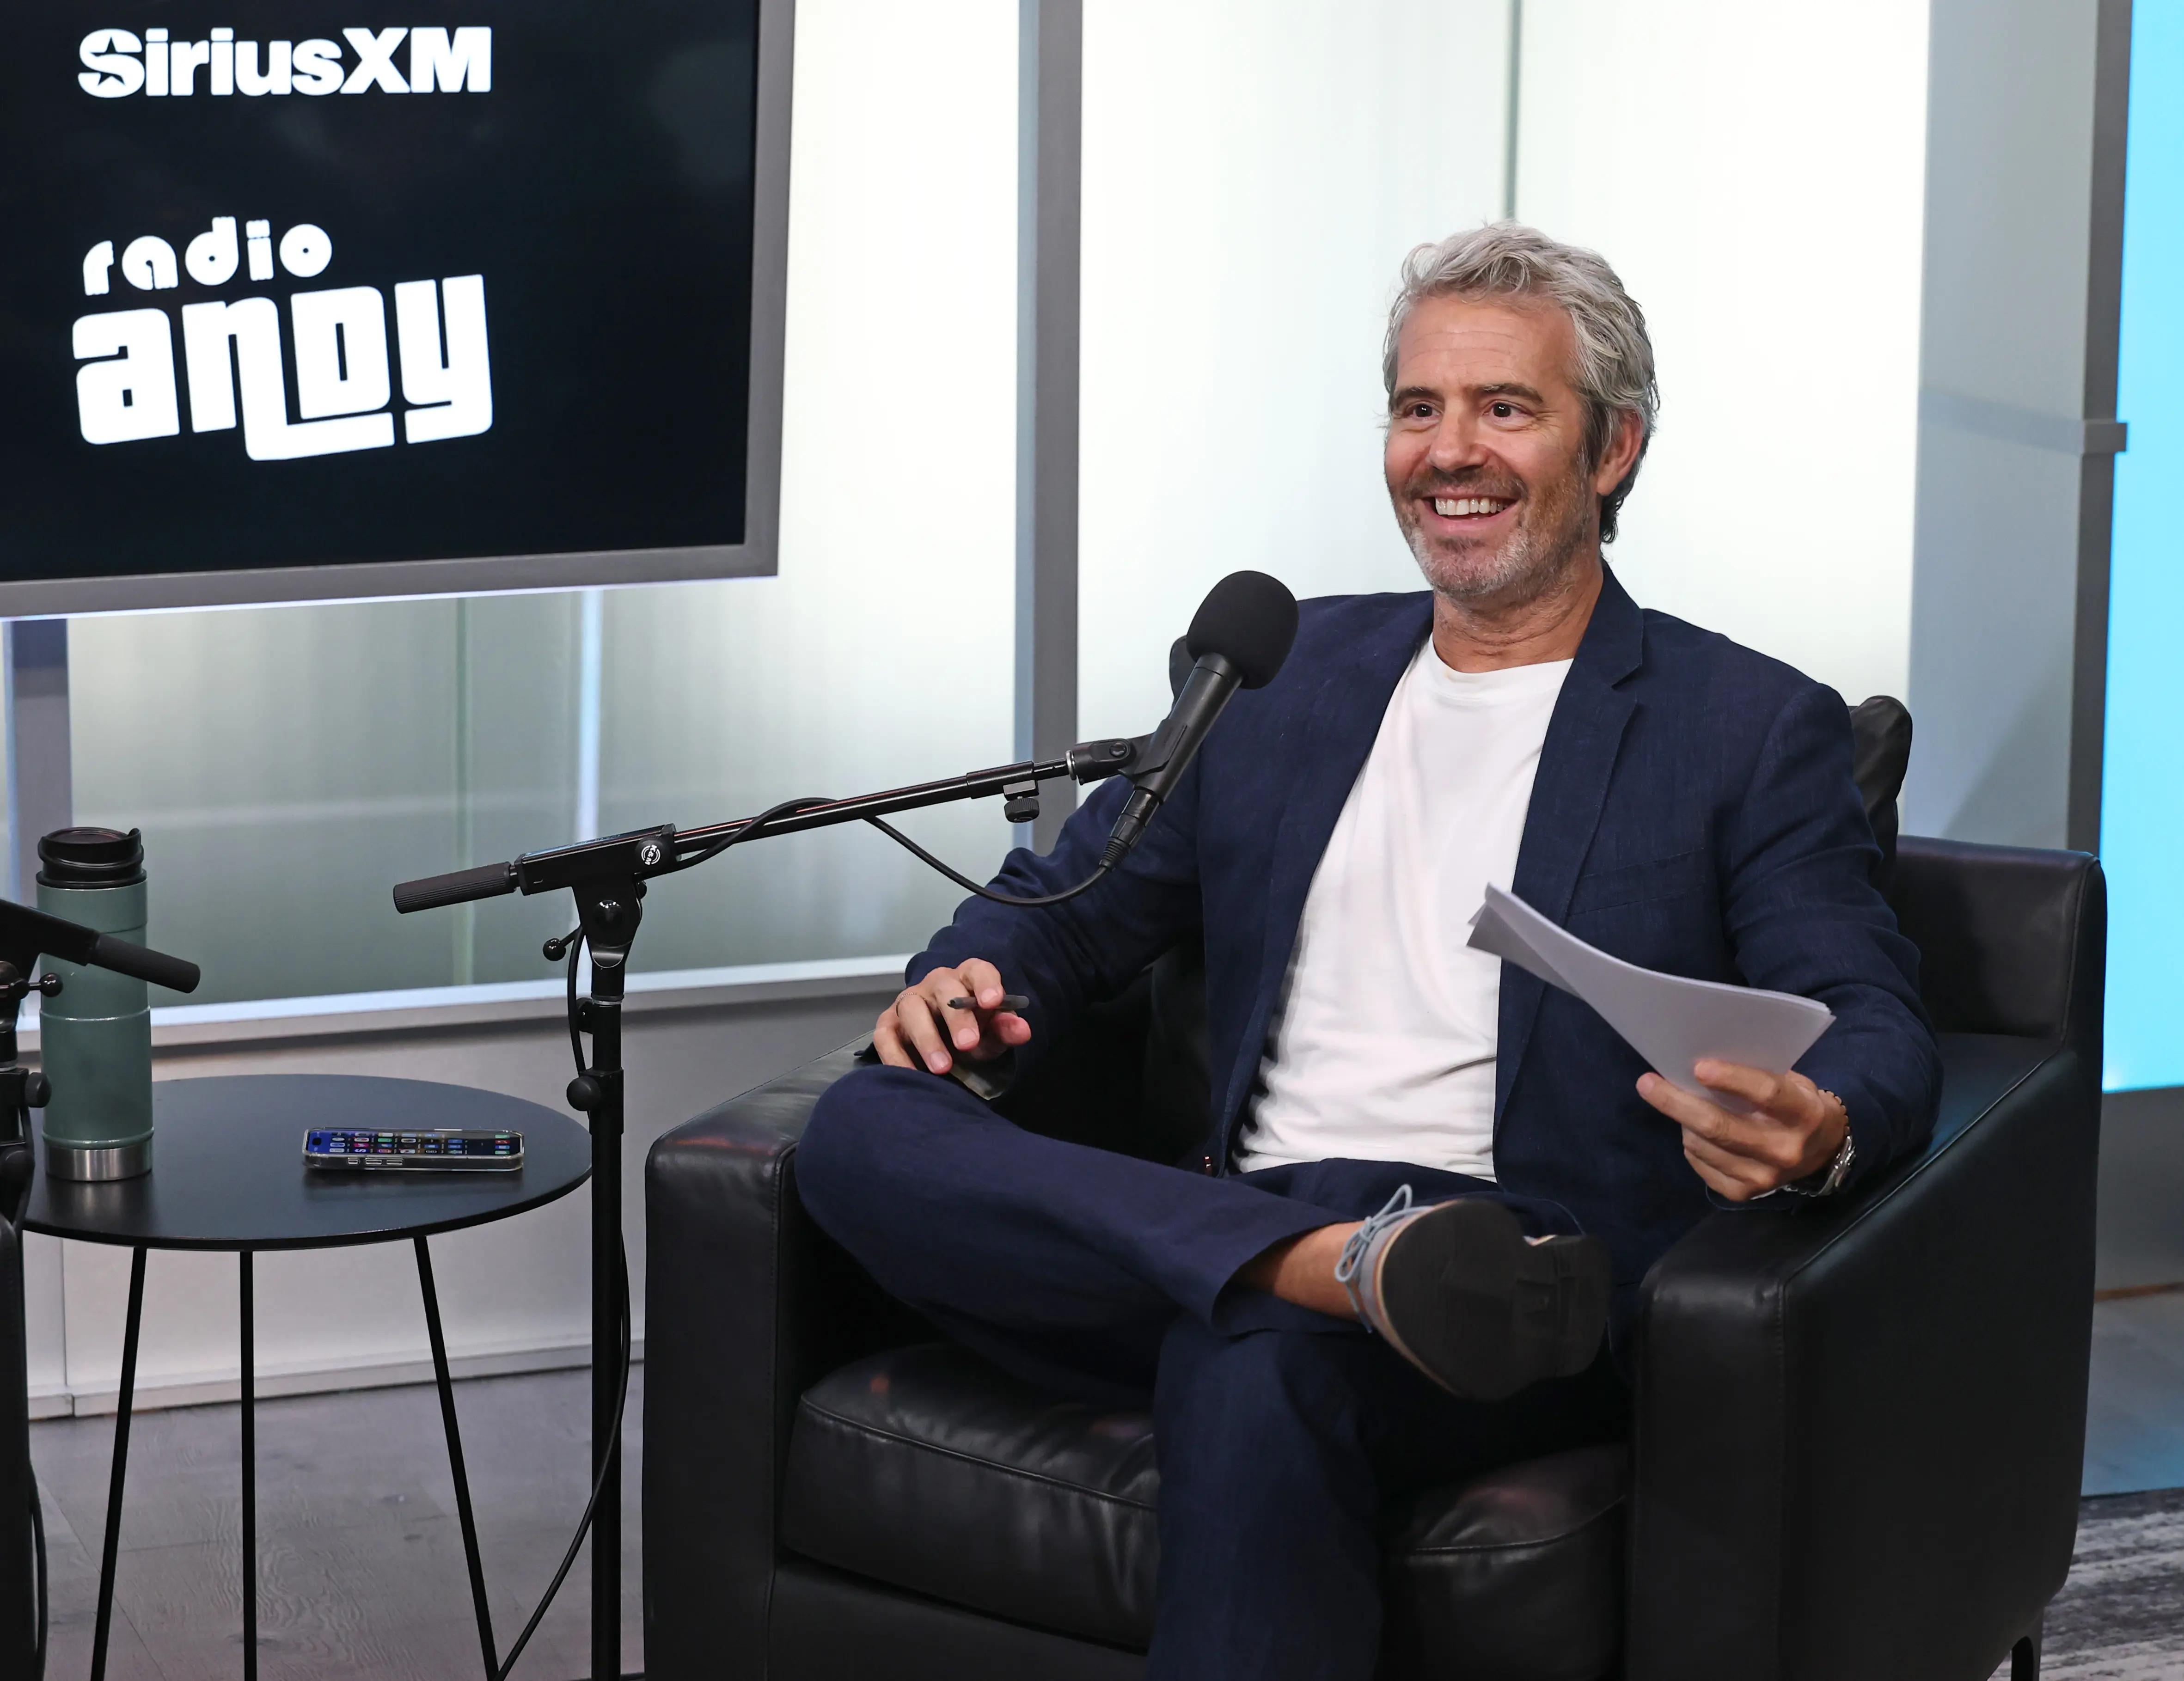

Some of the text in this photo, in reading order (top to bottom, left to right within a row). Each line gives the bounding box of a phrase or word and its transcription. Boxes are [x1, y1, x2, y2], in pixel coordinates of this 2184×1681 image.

[78, 26, 492, 98] SiriusXM
[83, 216, 332, 296] radio
[644, 844, 657, 865] K&M
